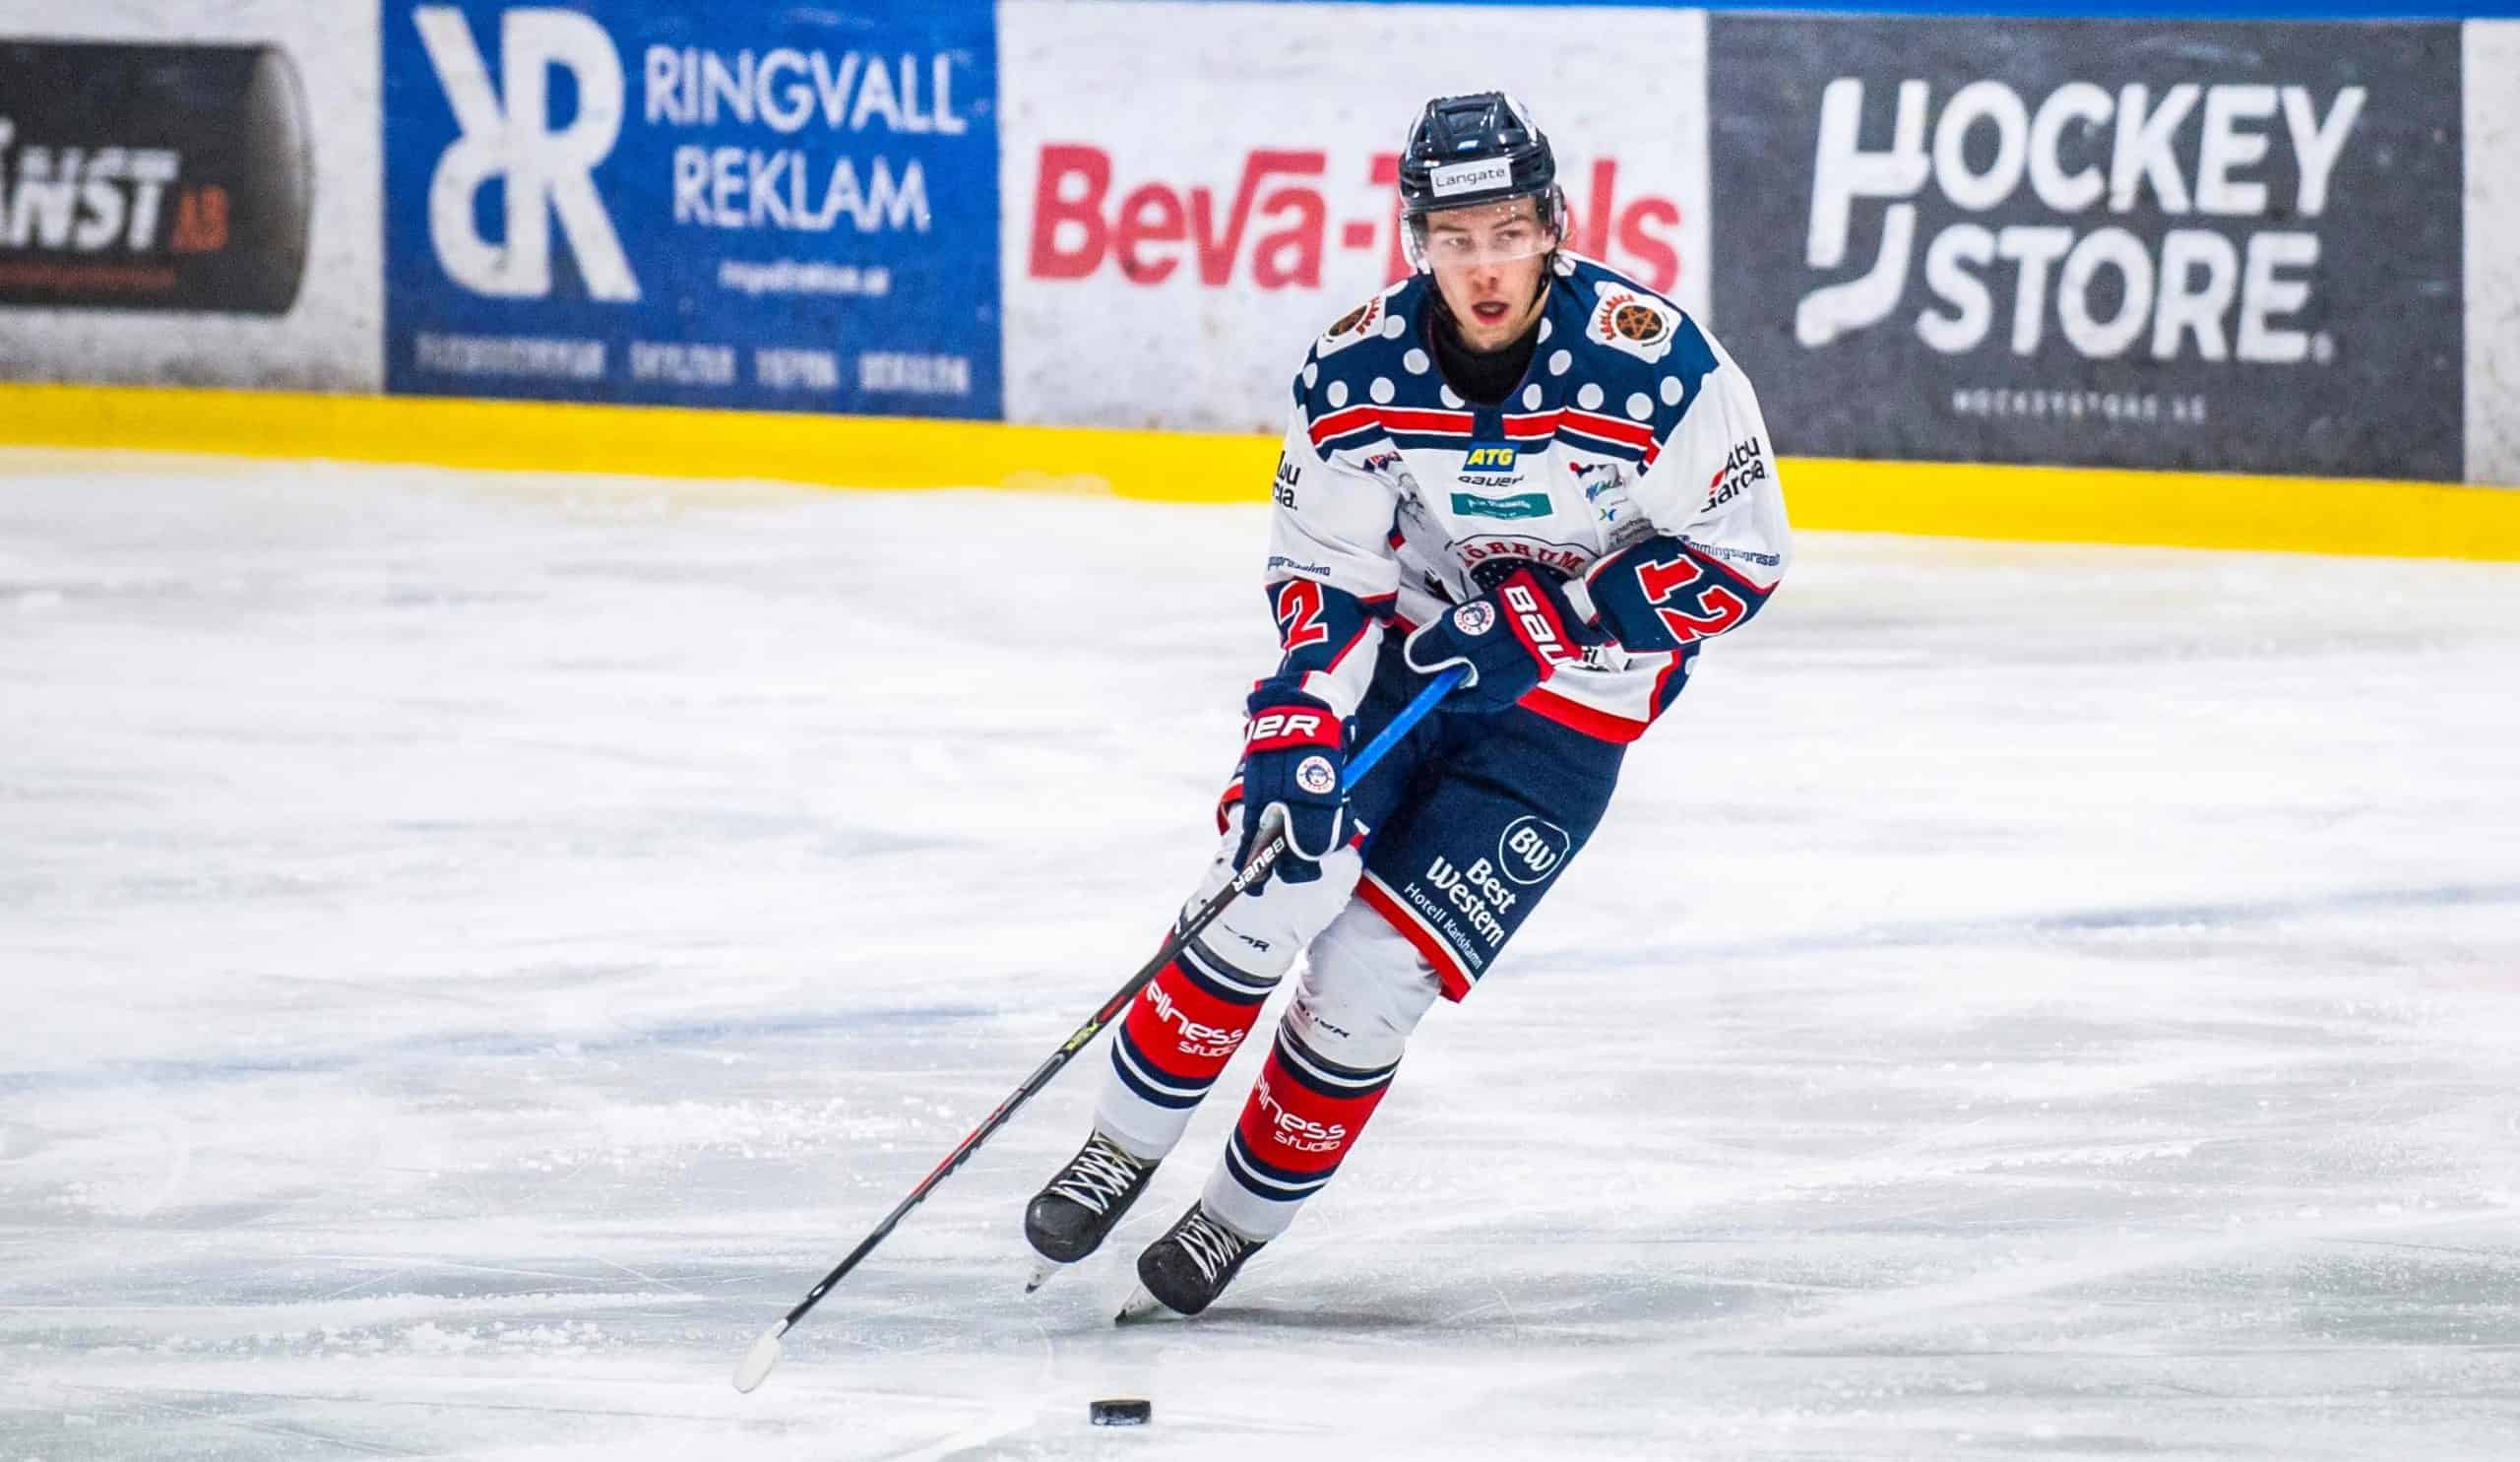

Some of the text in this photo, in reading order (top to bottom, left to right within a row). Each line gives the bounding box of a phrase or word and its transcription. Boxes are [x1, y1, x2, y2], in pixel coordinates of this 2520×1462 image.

[645, 45, 969, 135] RINGVALL
[673, 145, 932, 233] REKLAM
[1436, 166, 1506, 189] Langate
[1806, 77, 2367, 269] HOCKEY
[1028, 143, 1682, 292] Beva-Tls
[1467, 448, 1515, 466] ATG
[1724, 436, 1762, 476] Abu
[1634, 553, 1747, 645] 12
[1231, 836, 1287, 892] BAUER
[1466, 857, 1518, 915] Best
[1507, 826, 1557, 873] BW
[1403, 881, 1484, 970] Hotell Karlshamn
[1425, 856, 1506, 948] Western
[1273, 1130, 1342, 1153] studio
